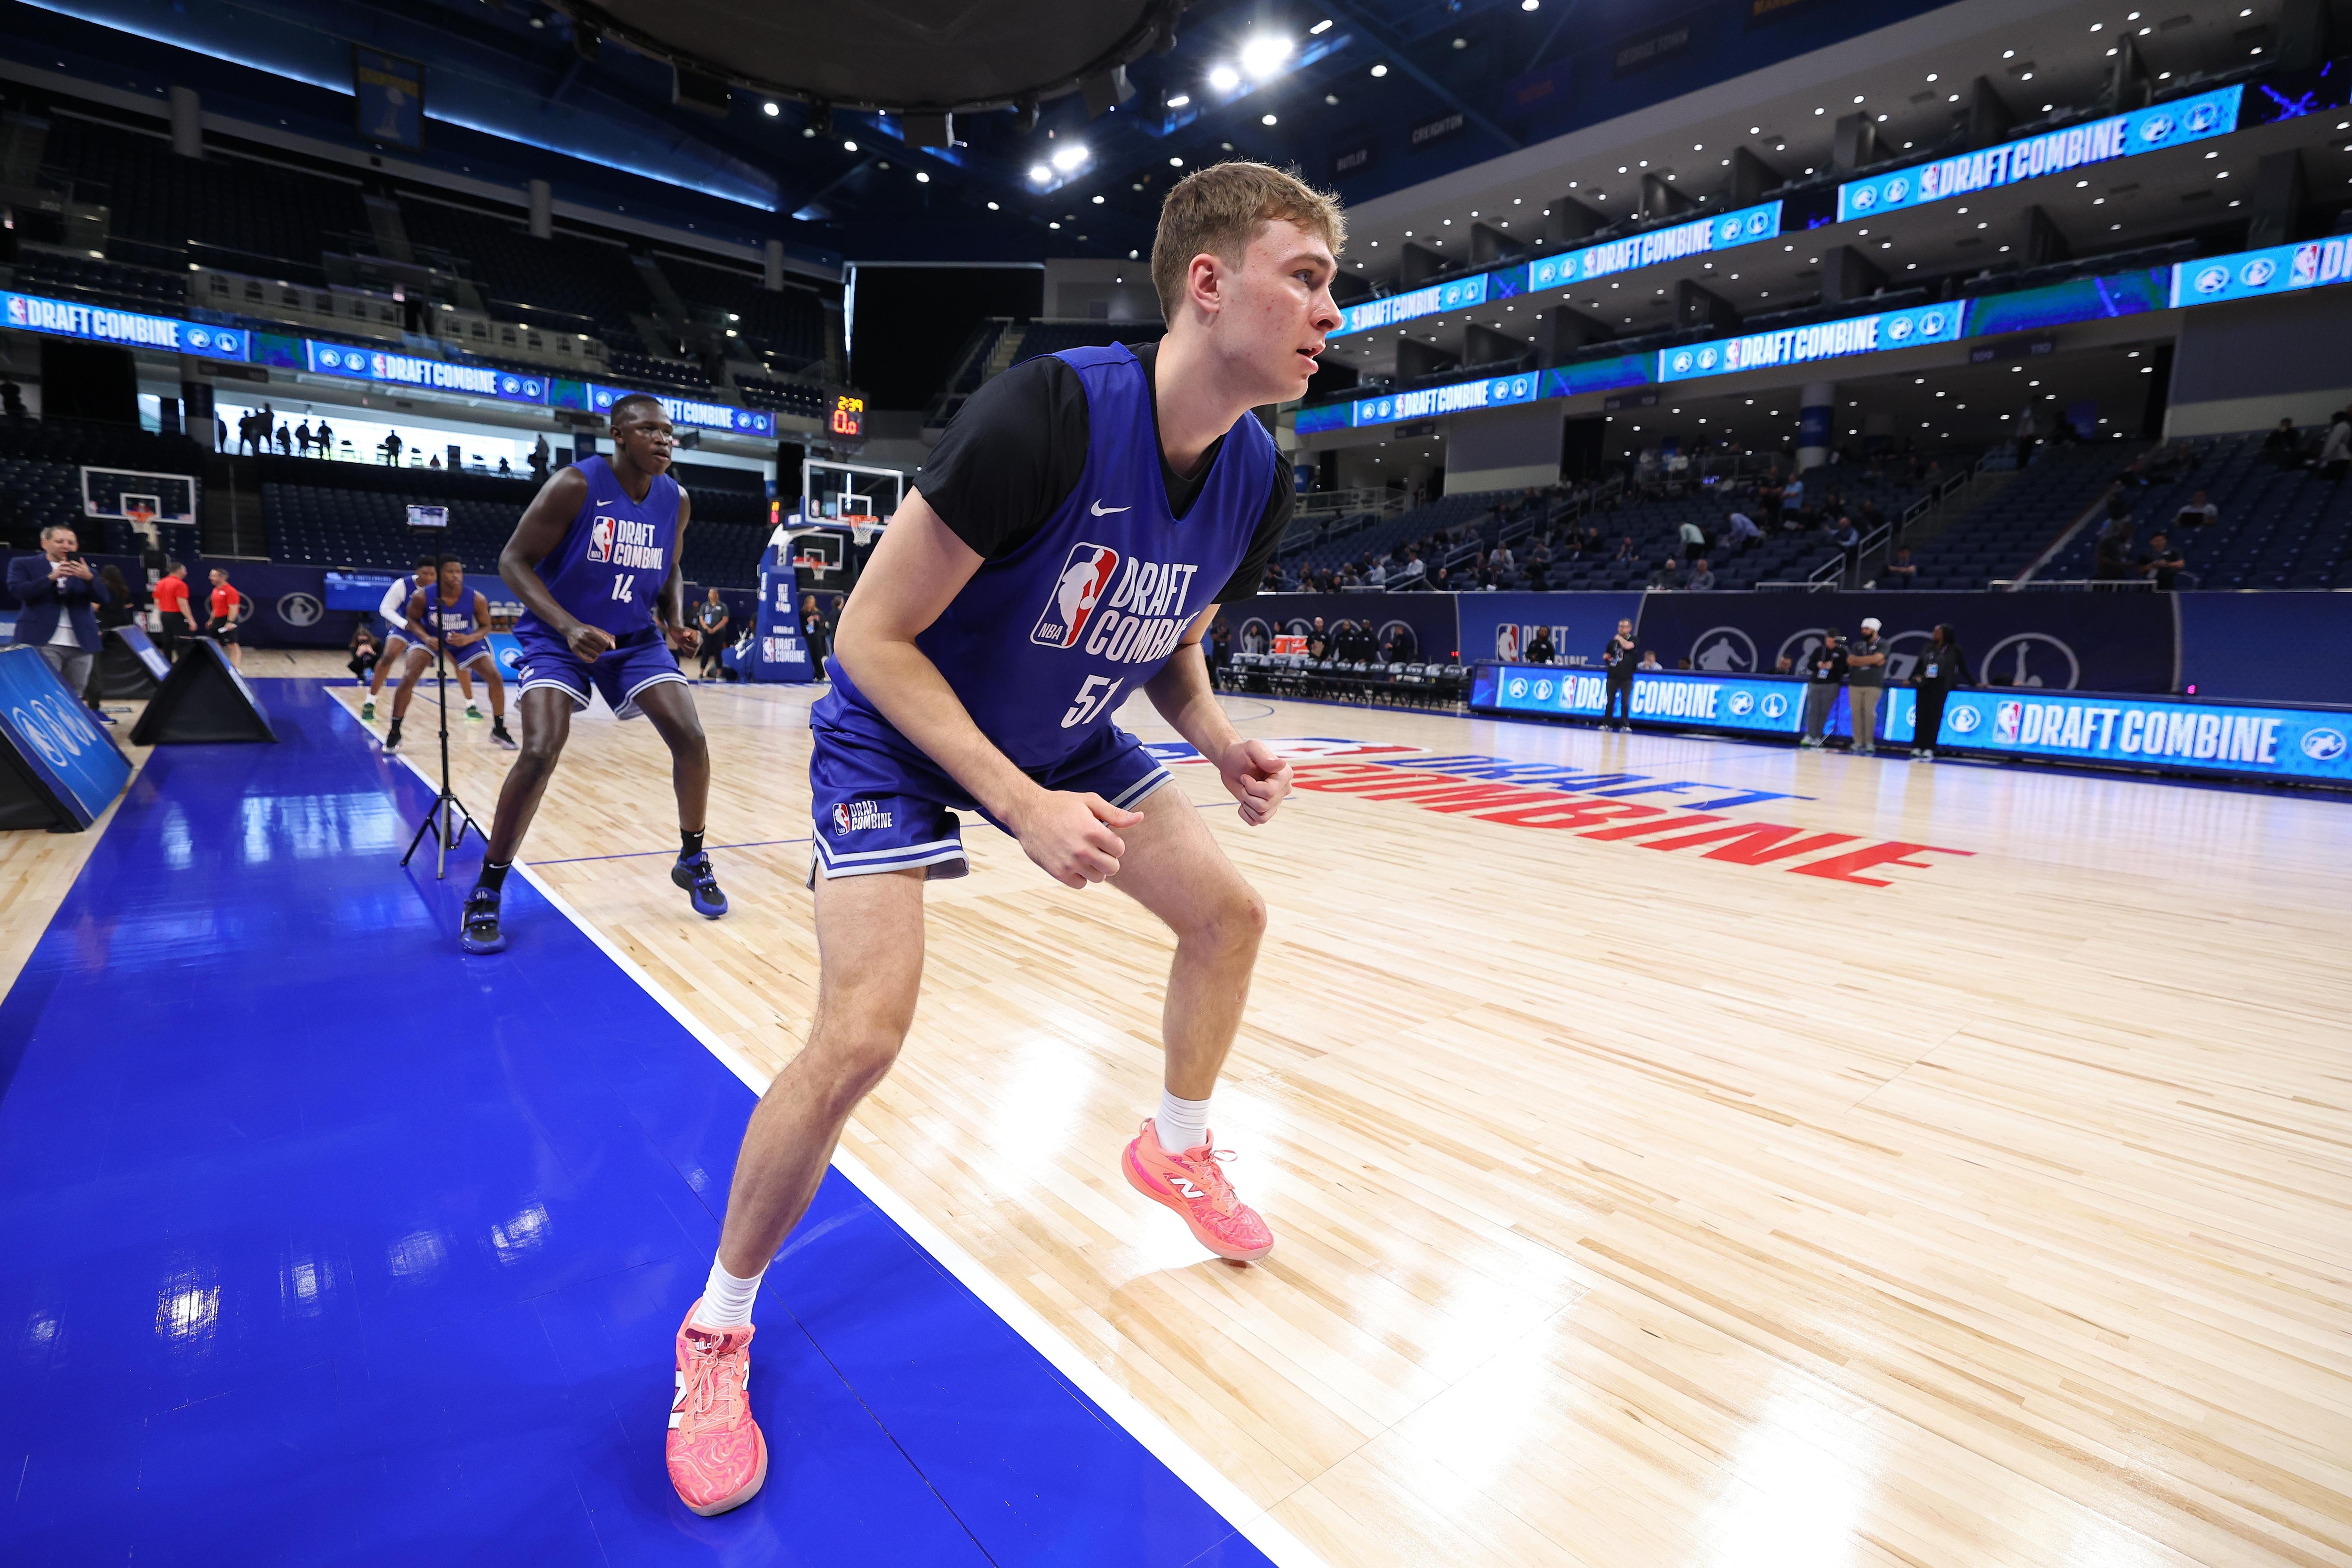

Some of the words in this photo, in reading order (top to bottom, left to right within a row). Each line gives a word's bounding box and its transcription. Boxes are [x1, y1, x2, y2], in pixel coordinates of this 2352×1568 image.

[1938, 145, 2015, 196] DRAFT
[2011, 118, 2128, 179] COMBINE
[1598, 238, 1643, 275] DRAFT
[1642, 220, 1714, 263] COMBINE
[27, 299, 91, 333] DRAFT
[94, 309, 181, 348] COMBINE
[1361, 300, 1393, 328] DRAFT
[1393, 286, 1442, 321] COMBINE
[1740, 331, 1796, 367] DRAFT
[1794, 316, 1880, 359] COMBINE
[386, 355, 433, 385] DRAFT
[433, 364, 497, 394] COMBINE
[683, 402, 734, 428] COMBINE
[838, 396, 863, 412] 2:39
[1405, 389, 1438, 415] DRAFT
[1437, 380, 1489, 412] COMBINE
[833, 409, 858, 435] 0.0
[617, 520, 655, 547] DRAFT
[612, 573, 635, 603] 14
[1108, 556, 1198, 616] DRAFT
[775, 638, 797, 650] DRAFT
[1038, 623, 1064, 640] NBA
[1523, 625, 1569, 654] DFT
[775, 650, 806, 663] COMBINE
[1061, 674, 1124, 728] 51
[1575, 677, 1620, 710] DRA
[1631, 680, 1721, 719] COMBINE
[2021, 704, 2120, 750] DRAFT
[2120, 710, 2281, 763] COMBINE
[1365, 755, 1818, 811] DRAFT
[849, 800, 878, 817] DRAFT
[851, 812, 892, 831] COMBINE
